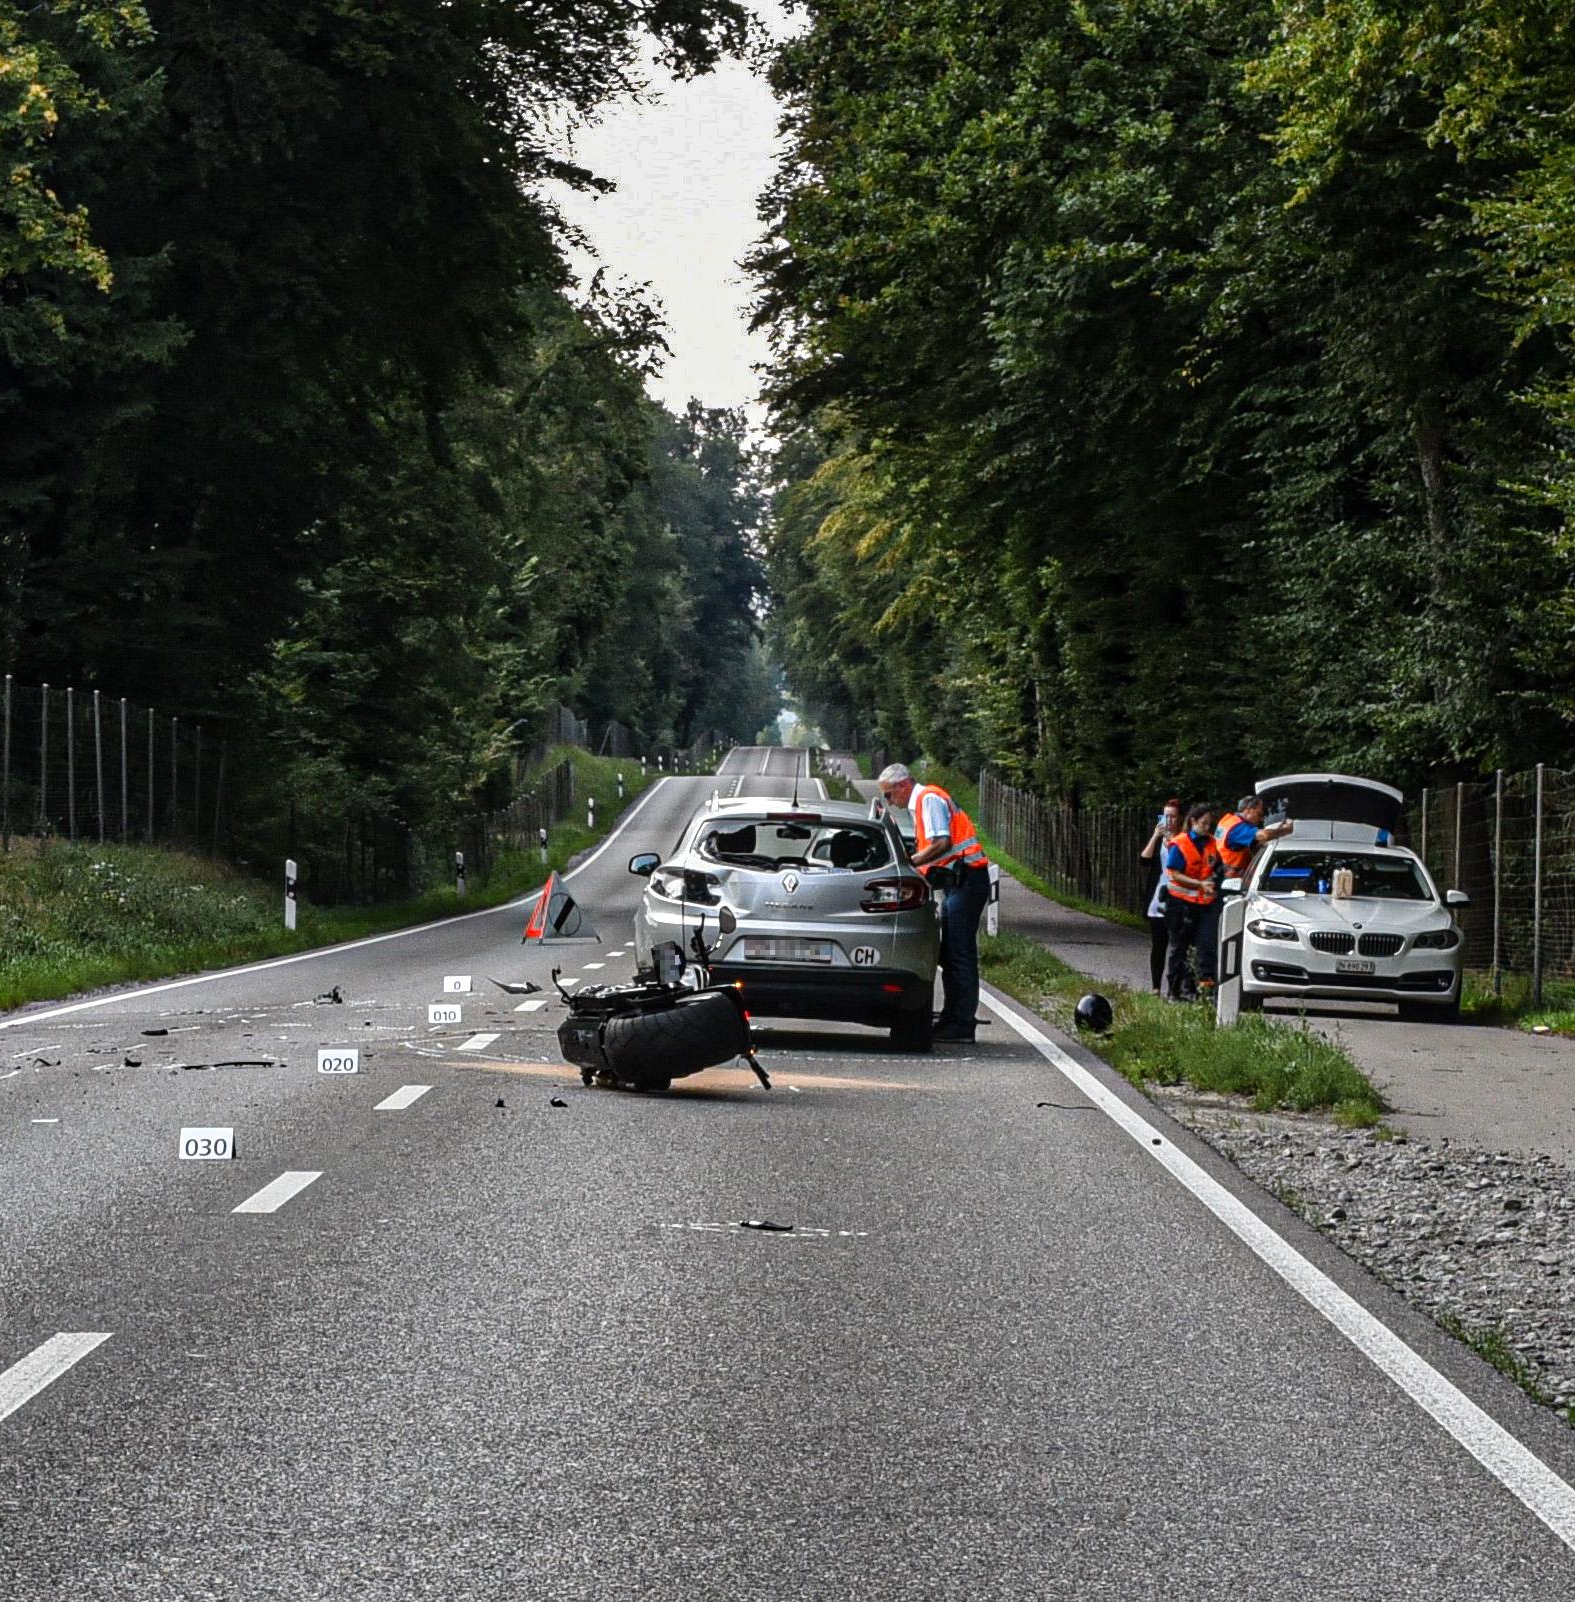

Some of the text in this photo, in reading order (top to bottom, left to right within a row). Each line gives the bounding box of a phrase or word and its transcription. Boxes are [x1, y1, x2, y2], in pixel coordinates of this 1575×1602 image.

[854, 948, 875, 965] CH
[453, 981, 461, 990] 0
[433, 1011, 457, 1021] 010
[322, 1057, 354, 1072] 020
[185, 1138, 227, 1157] 030
